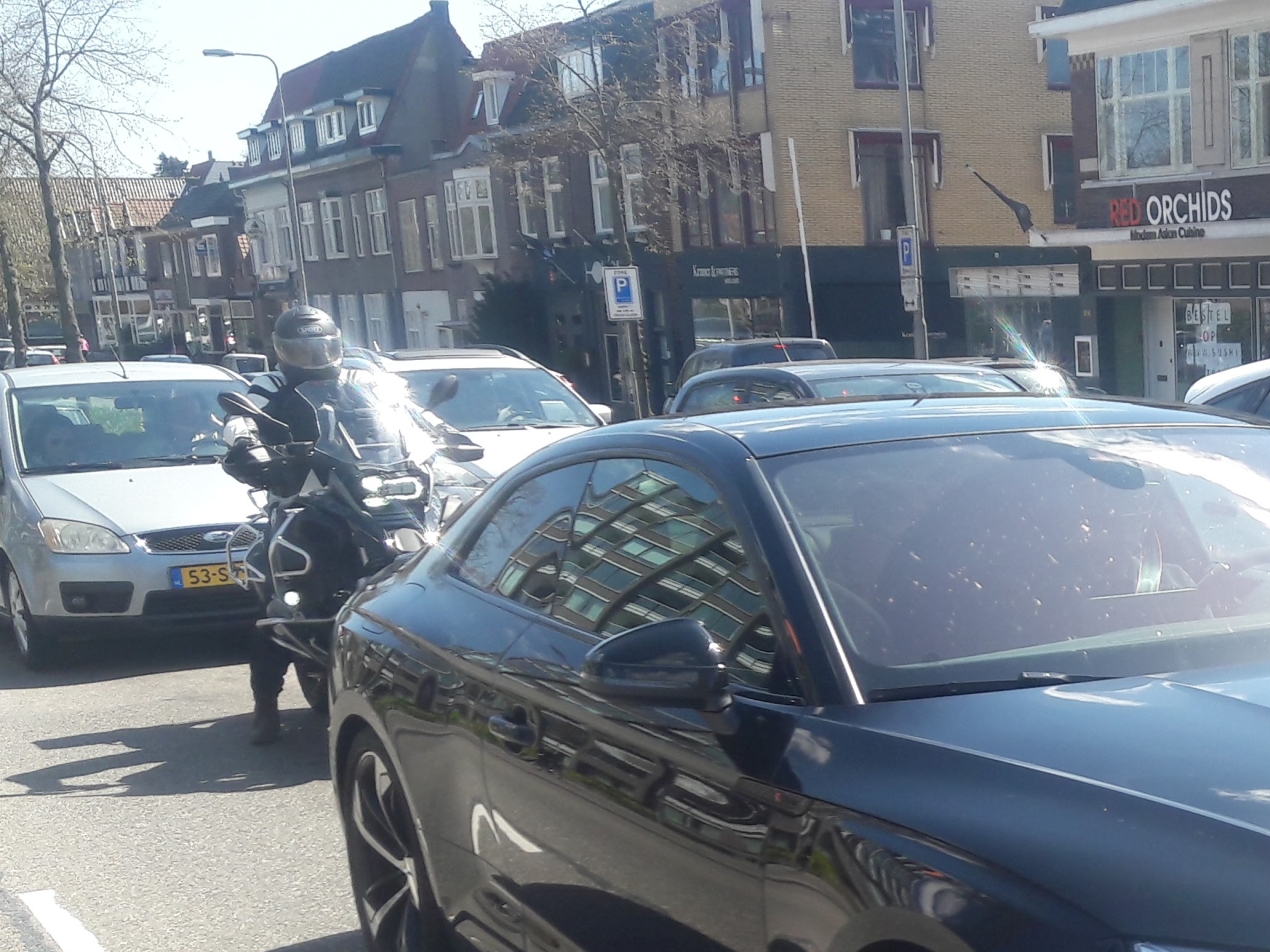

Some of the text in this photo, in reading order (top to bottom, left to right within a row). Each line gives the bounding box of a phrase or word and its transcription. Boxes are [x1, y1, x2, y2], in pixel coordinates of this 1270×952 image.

[1110, 189, 1232, 226] RED ORCHIDS
[1158, 228, 1177, 239] Asian
[1178, 226, 1206, 238] Cuisine
[616, 278, 628, 293] P
[1187, 310, 1229, 321] BESTEL
[1203, 331, 1216, 342] OP
[188, 566, 238, 585] 53-S
